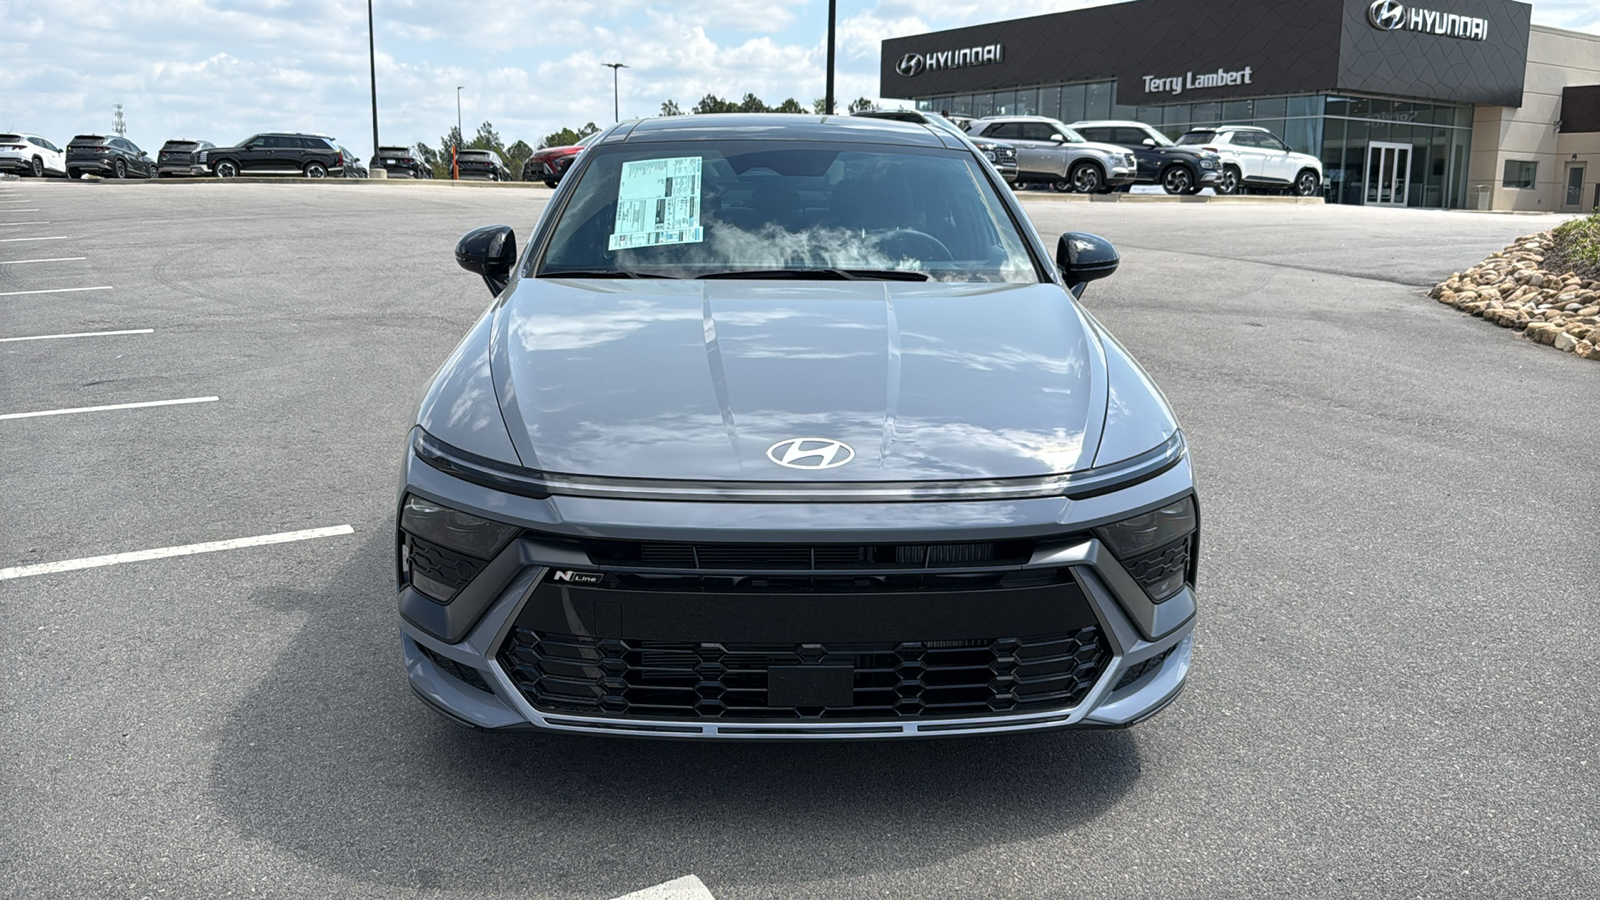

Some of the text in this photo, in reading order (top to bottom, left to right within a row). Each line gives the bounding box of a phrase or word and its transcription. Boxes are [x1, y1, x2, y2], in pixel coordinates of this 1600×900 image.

[1409, 7, 1488, 40] HYUNDAI
[926, 43, 1002, 71] HYUNDAI
[1142, 66, 1252, 95] Terry Lambert
[553, 570, 574, 582] N
